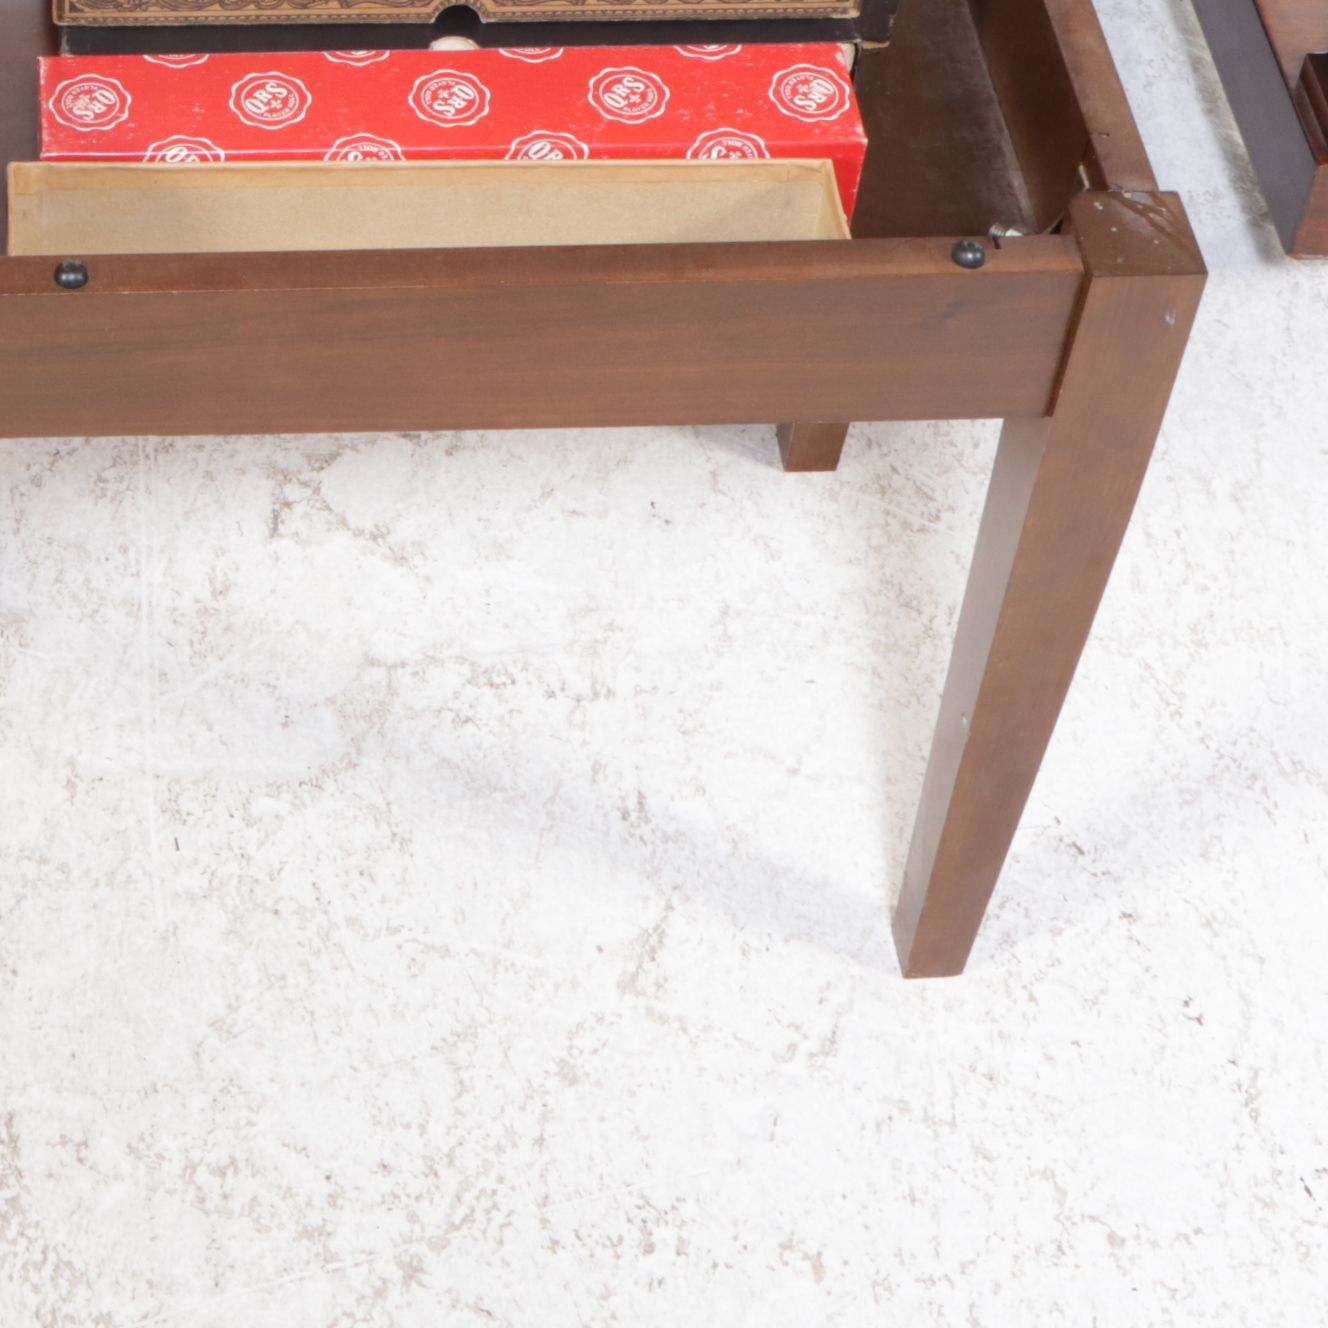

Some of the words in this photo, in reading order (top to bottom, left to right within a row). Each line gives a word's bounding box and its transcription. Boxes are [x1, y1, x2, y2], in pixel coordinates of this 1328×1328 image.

[73, 89, 116, 121] QRS
[245, 82, 288, 114] QRS
[433, 84, 475, 117] QRS
[604, 77, 645, 108] QRS
[794, 79, 834, 111] QRS
